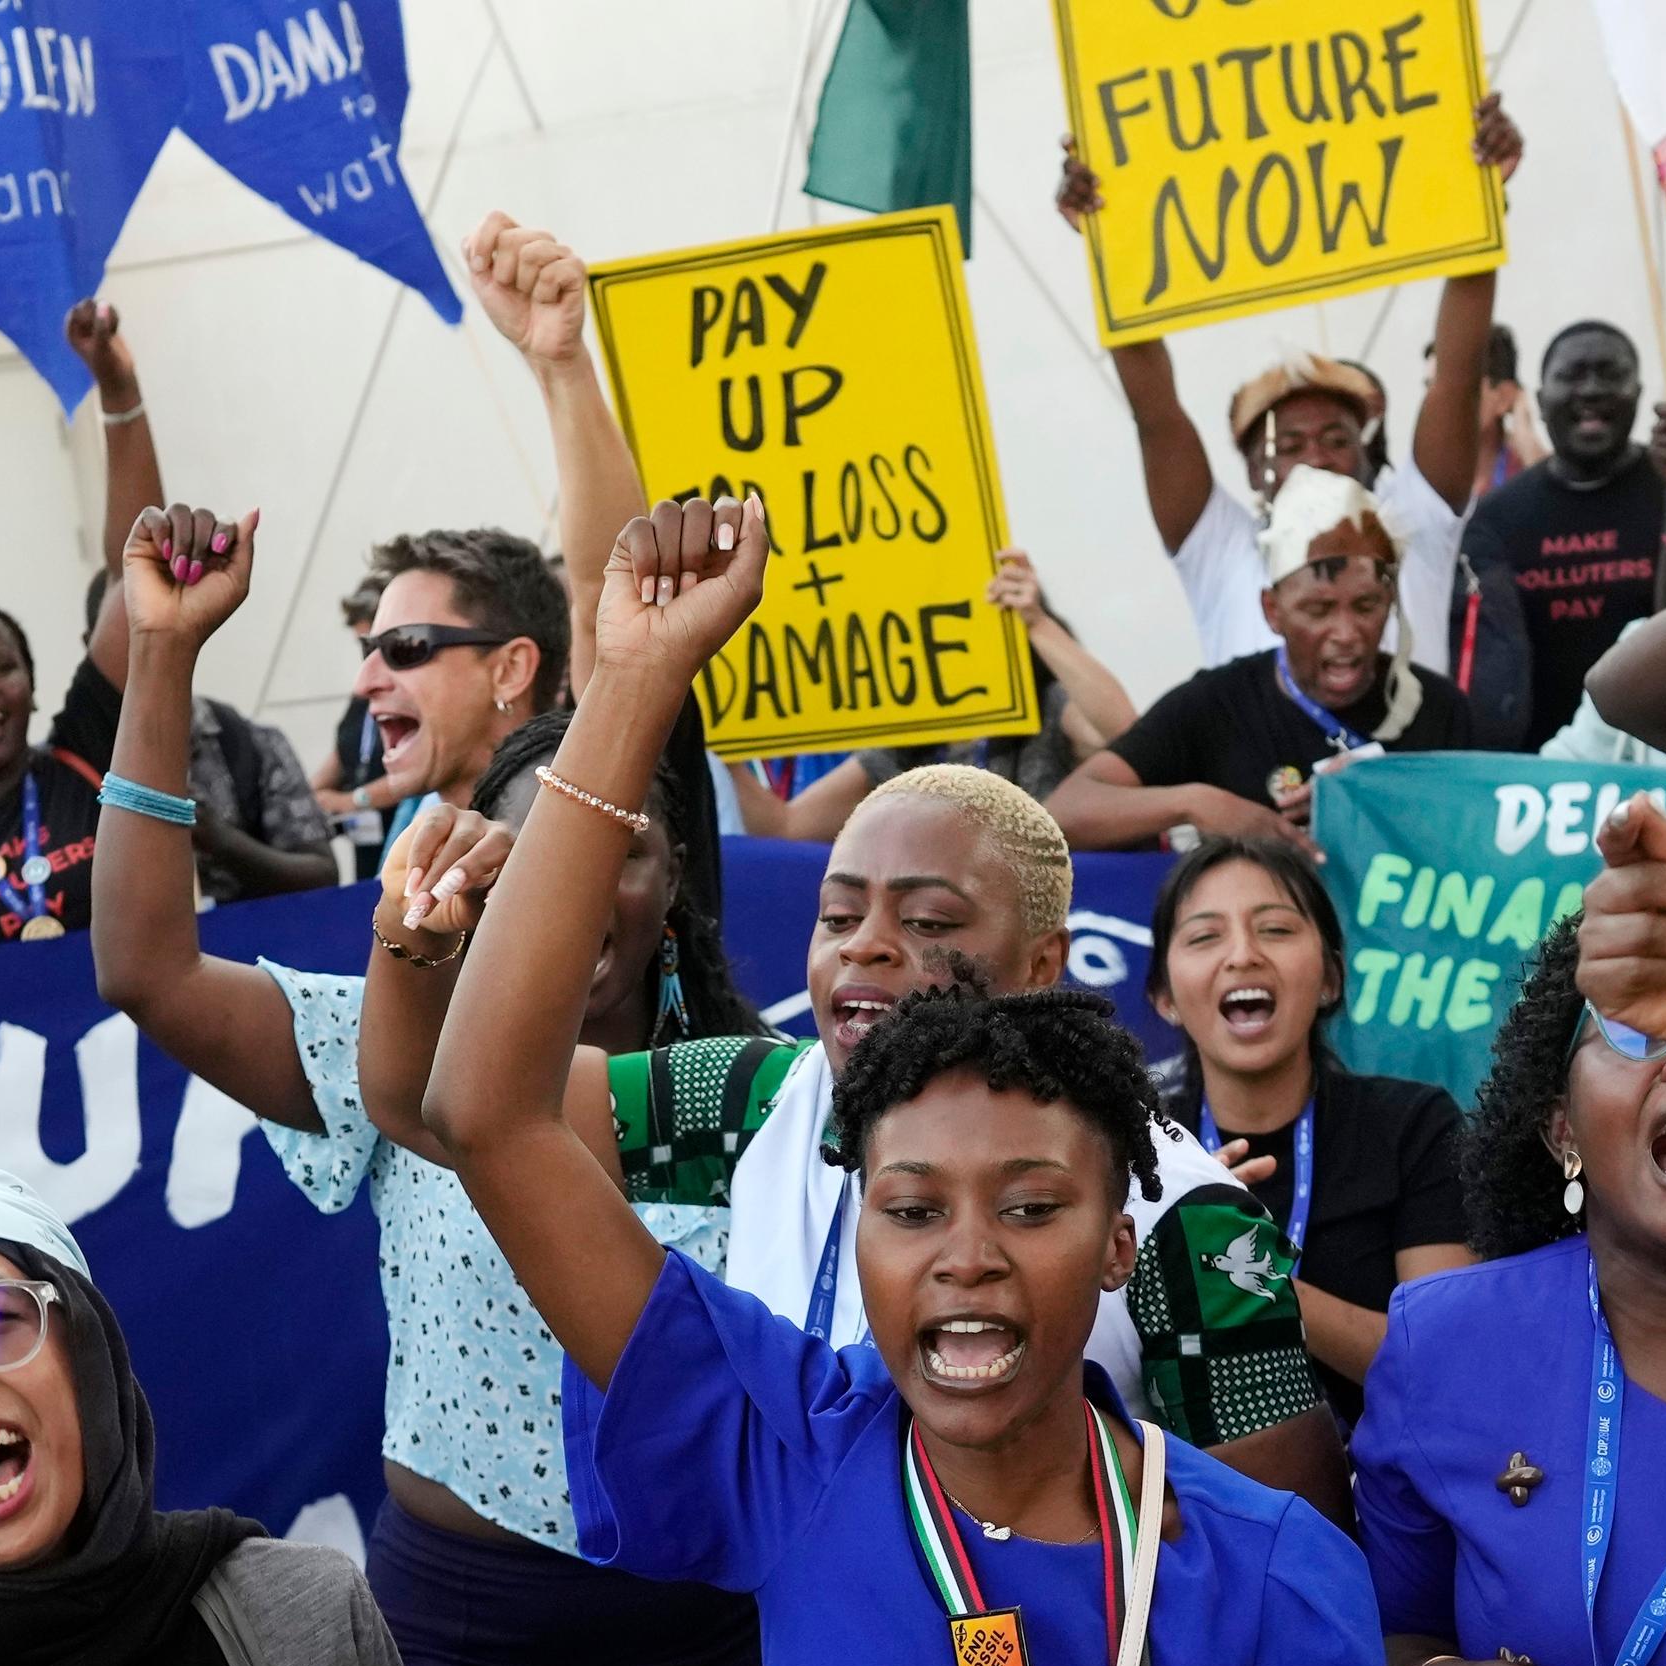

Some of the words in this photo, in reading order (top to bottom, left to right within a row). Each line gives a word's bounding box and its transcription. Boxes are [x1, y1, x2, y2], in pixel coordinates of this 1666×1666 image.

[1098, 13, 1439, 167] FUTURE
[1143, 136, 1403, 305] NOW
[689, 261, 827, 368] PAY
[719, 364, 843, 453] UP
[801, 444, 949, 554] LOSS
[1541, 529, 1618, 556] MAKE
[1550, 595, 1603, 620] PAY
[701, 600, 988, 728] DAMAGE
[1350, 949, 1500, 1032] THE
[963, 1629, 986, 1665] END
